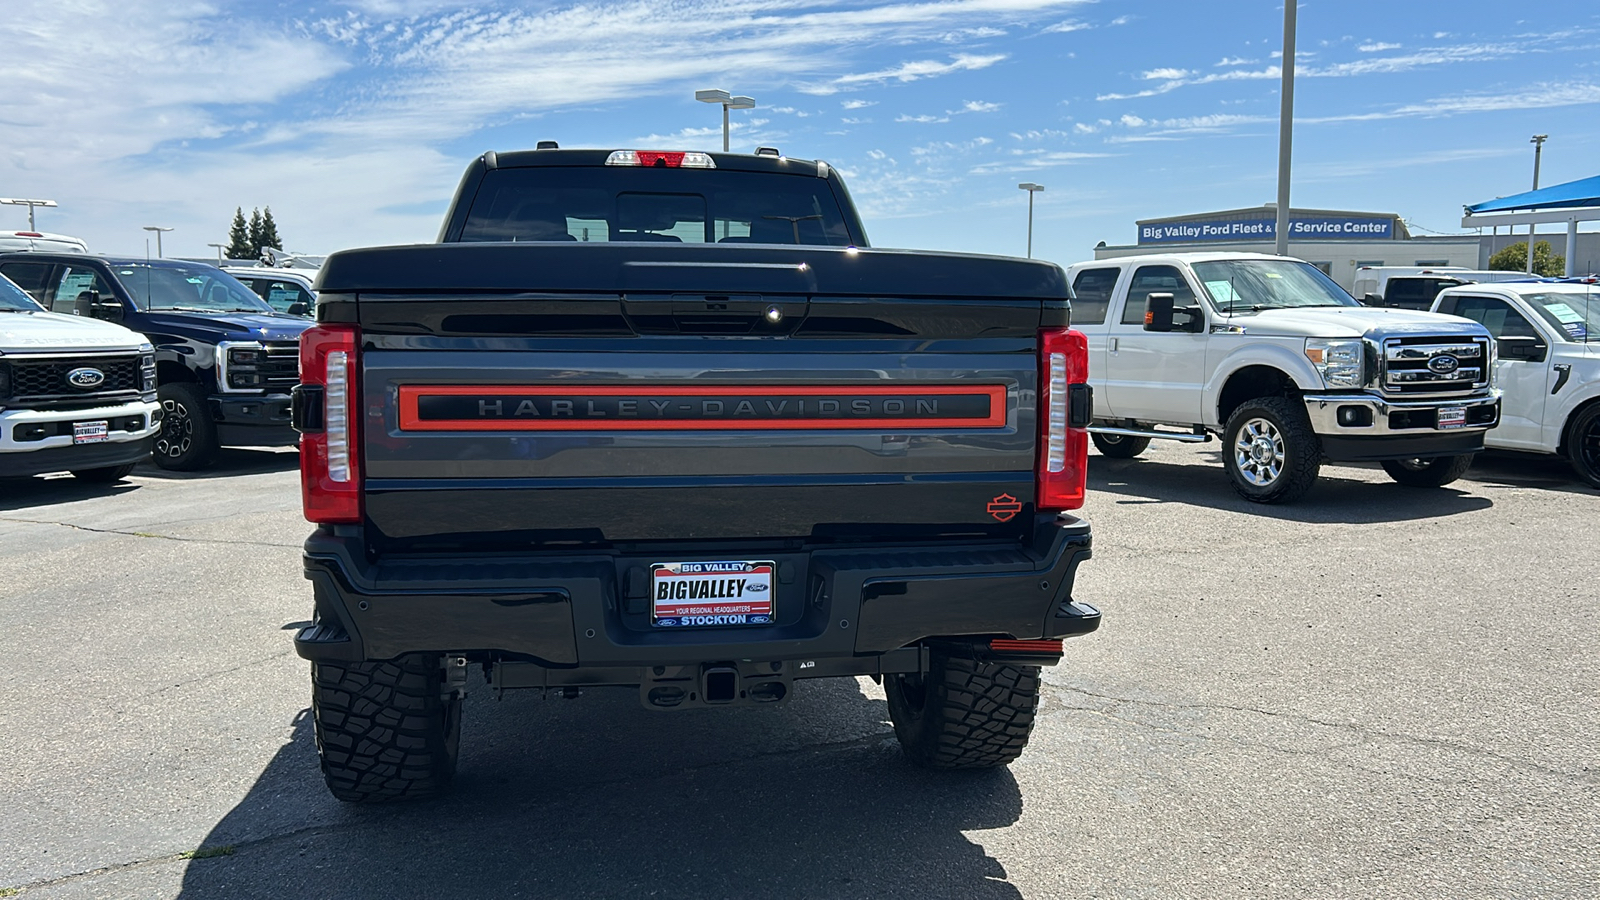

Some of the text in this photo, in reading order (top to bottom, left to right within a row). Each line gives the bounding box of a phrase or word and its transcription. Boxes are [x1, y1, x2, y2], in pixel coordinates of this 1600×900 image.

[1143, 228, 1162, 239] Big
[1164, 225, 1200, 238] Valley
[1203, 224, 1230, 235] Ford
[1232, 223, 1263, 234] Fleet
[1265, 225, 1272, 233] &
[1294, 221, 1341, 233] Service
[1344, 222, 1387, 233] Center
[478, 398, 939, 417] HARLEY-DAVIDSON
[682, 563, 746, 572] BIG VALLEY
[657, 578, 747, 600] BIGVALLEY
[675, 605, 751, 615] YOUR REGIONAL HEADQUARTERS
[681, 614, 747, 626] STOCKTON
